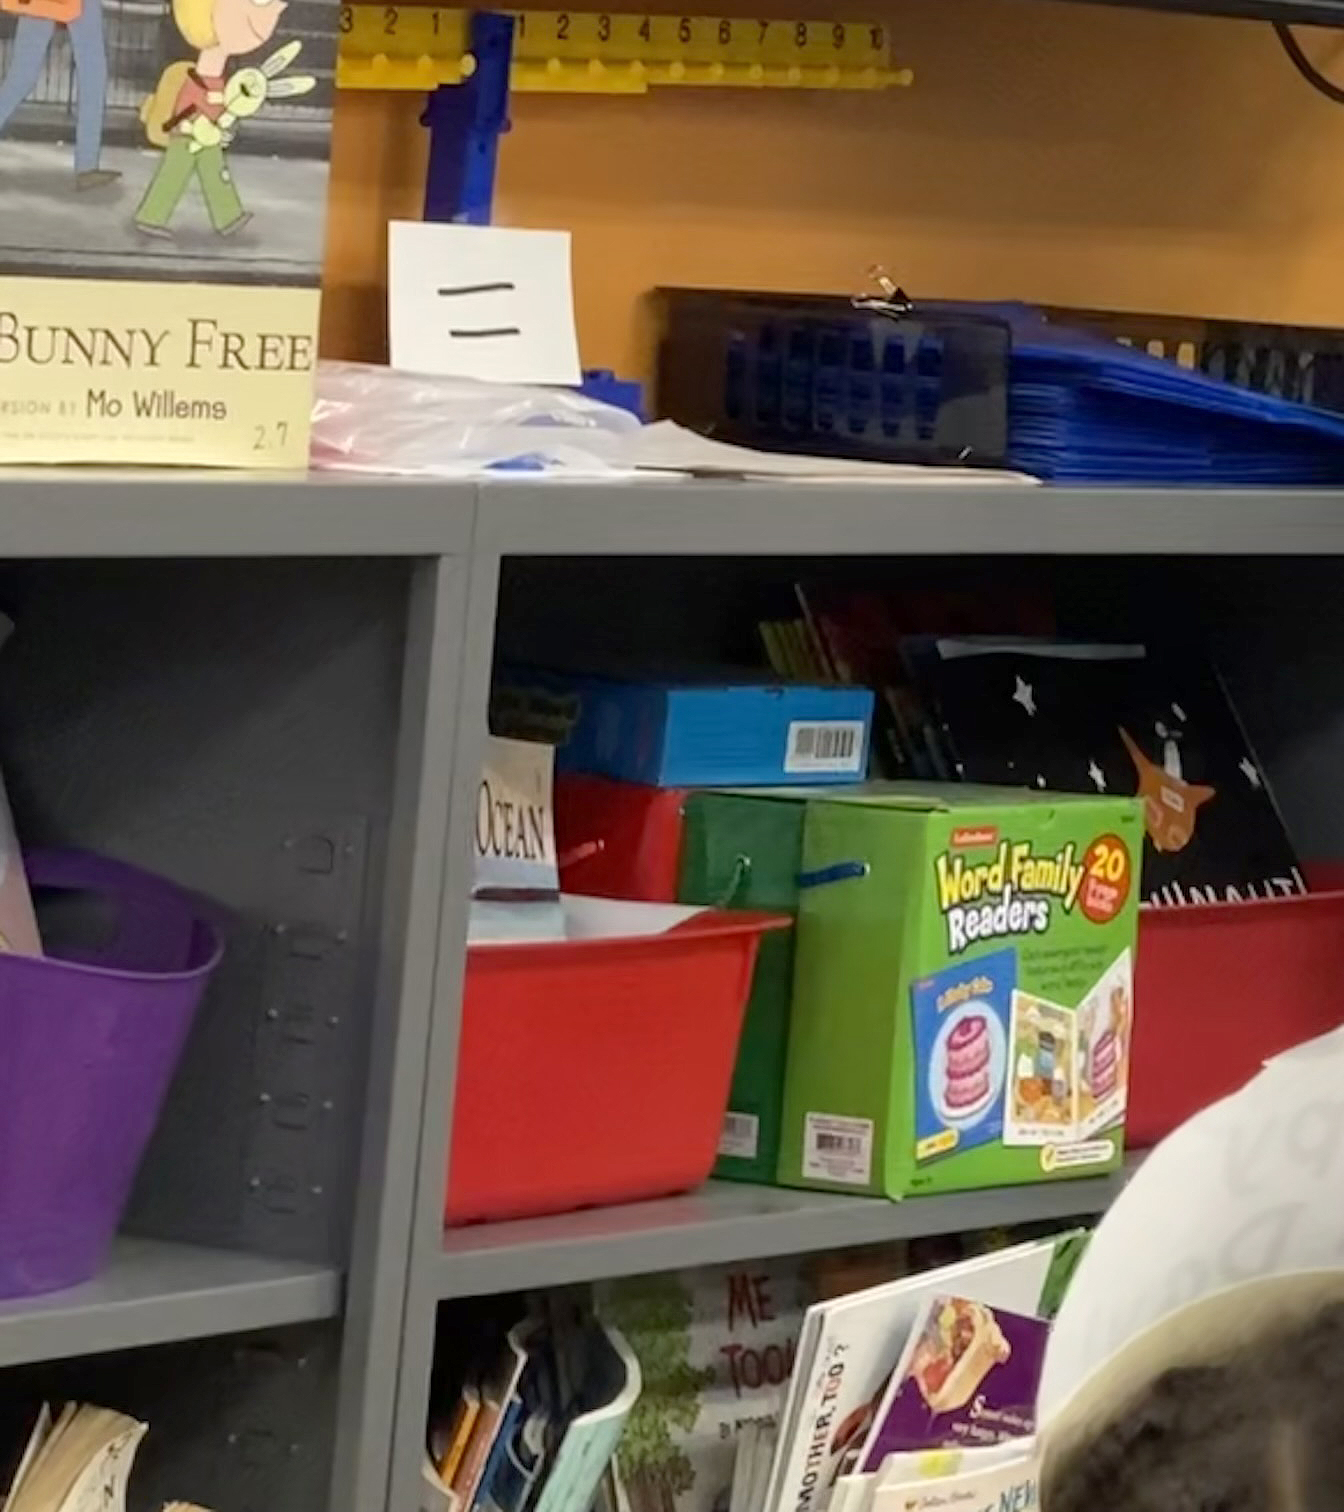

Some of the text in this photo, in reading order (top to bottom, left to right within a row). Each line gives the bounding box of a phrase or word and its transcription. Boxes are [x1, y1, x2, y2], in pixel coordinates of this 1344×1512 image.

[556, 14, 571, 40] 2
[598, 14, 611, 42] 3
[637, 17, 650, 42] 4
[678, 17, 692, 43] 5
[718, 19, 732, 45] 6
[794, 22, 808, 47] 8
[832, 23, 846, 50] 9
[186, 317, 314, 372] FREE
[86, 388, 228, 420] Mo Willems
[476, 779, 546, 861] OCEAN
[935, 839, 1010, 914] Word
[1009, 840, 1086, 914] Family
[1088, 843, 1126, 883] 20
[947, 882, 1050, 955] Readers
[727, 1272, 777, 1332] ME
